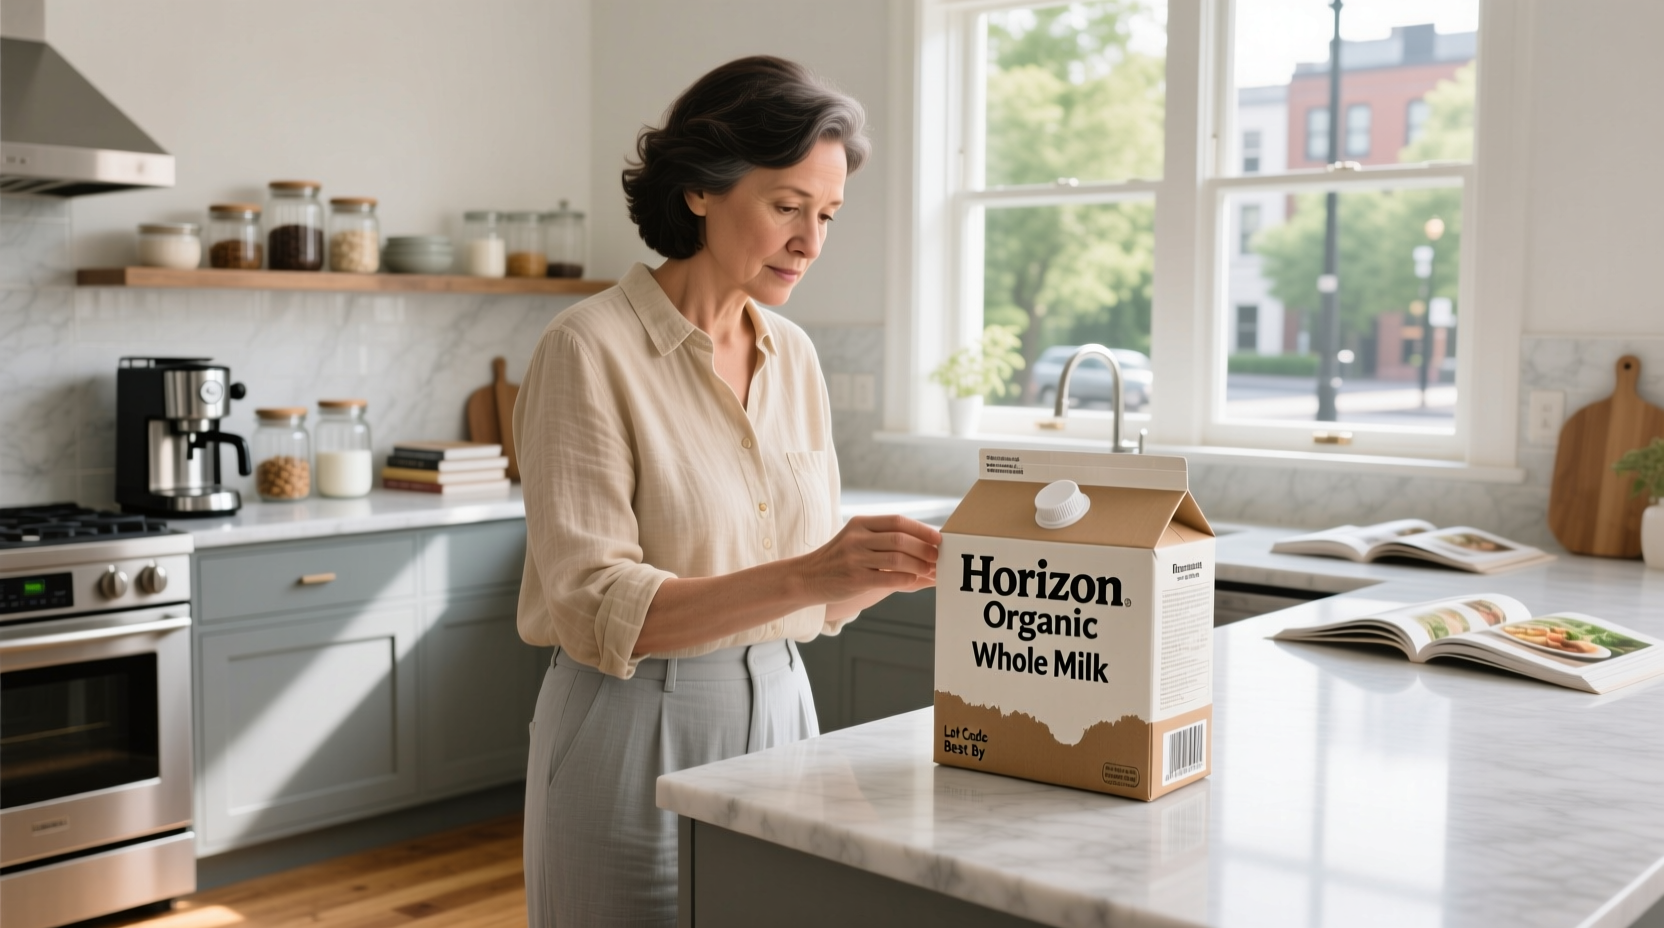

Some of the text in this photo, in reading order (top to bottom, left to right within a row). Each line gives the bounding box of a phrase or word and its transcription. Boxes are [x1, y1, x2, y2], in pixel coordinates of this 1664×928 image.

[983, 600, 1098, 642] Organic
[971, 640, 1109, 684] Whole Milk
[943, 740, 986, 762] Best By
